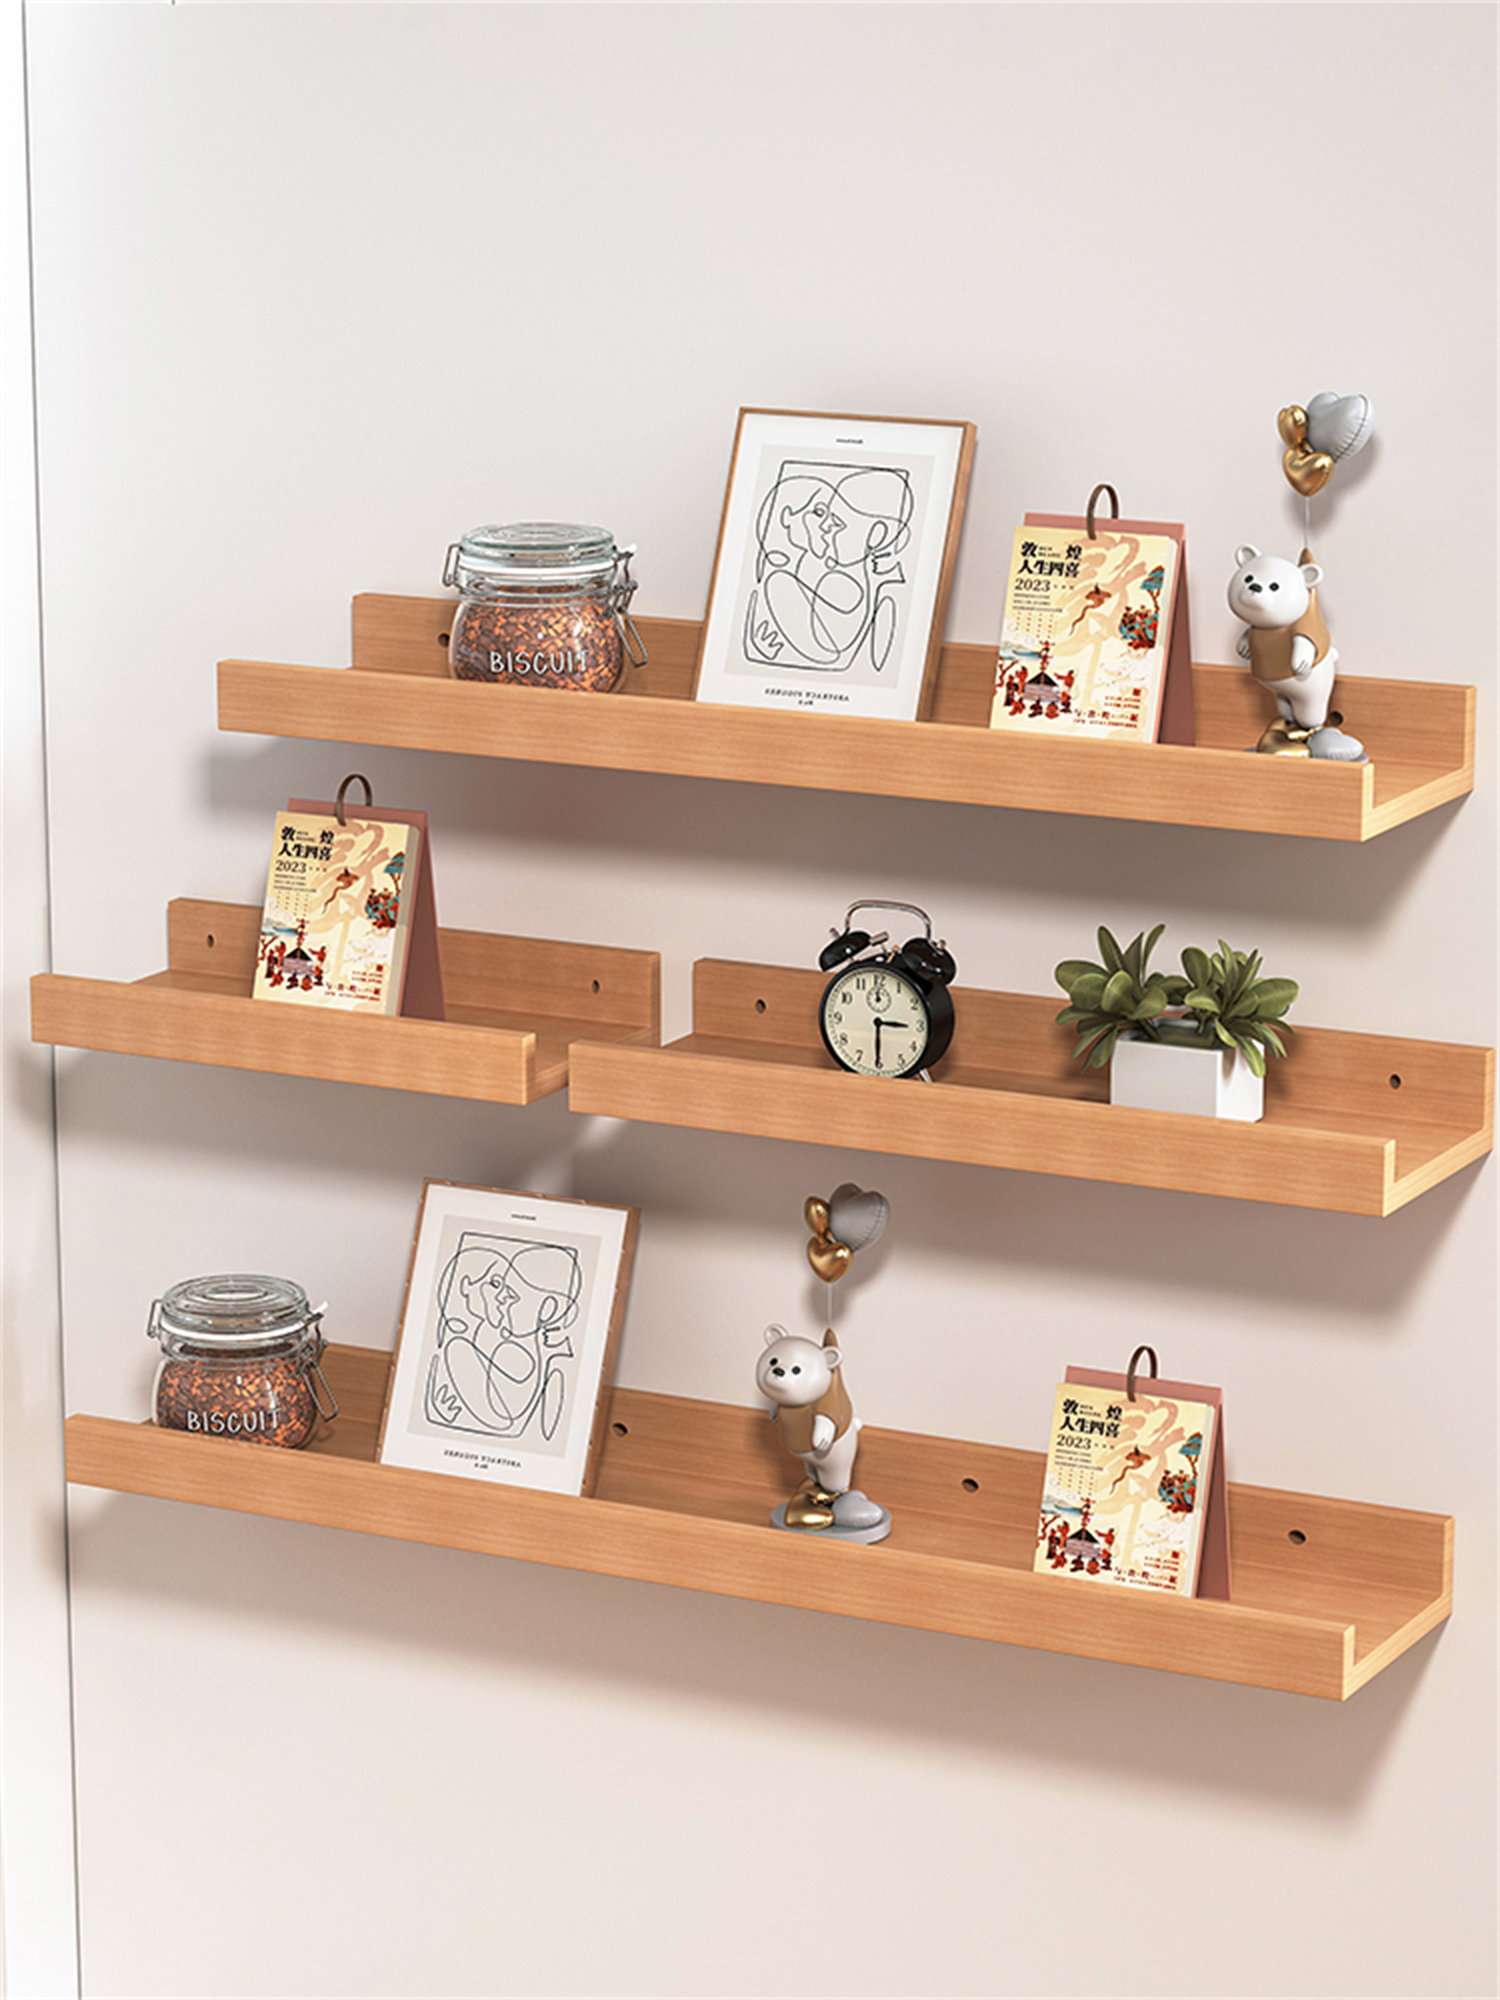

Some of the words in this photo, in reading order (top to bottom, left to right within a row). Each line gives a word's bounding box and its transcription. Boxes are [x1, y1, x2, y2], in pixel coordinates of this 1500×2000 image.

[1017, 559, 1080, 578] 人生四喜
[1014, 577, 1051, 592] 2023
[490, 651, 590, 675] BISCUIT
[278, 842, 332, 861] 人生四喜
[275, 860, 307, 873] 2023
[856, 977, 866, 990] 11
[873, 974, 886, 987] 12
[897, 981, 901, 994] 1
[842, 991, 853, 1005] 10
[910, 997, 919, 1011] 2
[834, 1011, 842, 1024] 9
[916, 1019, 925, 1033] 3
[840, 1033, 848, 1046] 8
[910, 1041, 917, 1053] 4
[855, 1049, 863, 1062] 7
[898, 1053, 906, 1067] 5
[187, 1408, 282, 1433] BISCUIT
[1060, 1416, 1120, 1438] 人生四喜
[1056, 1433, 1092, 1450] 2023
